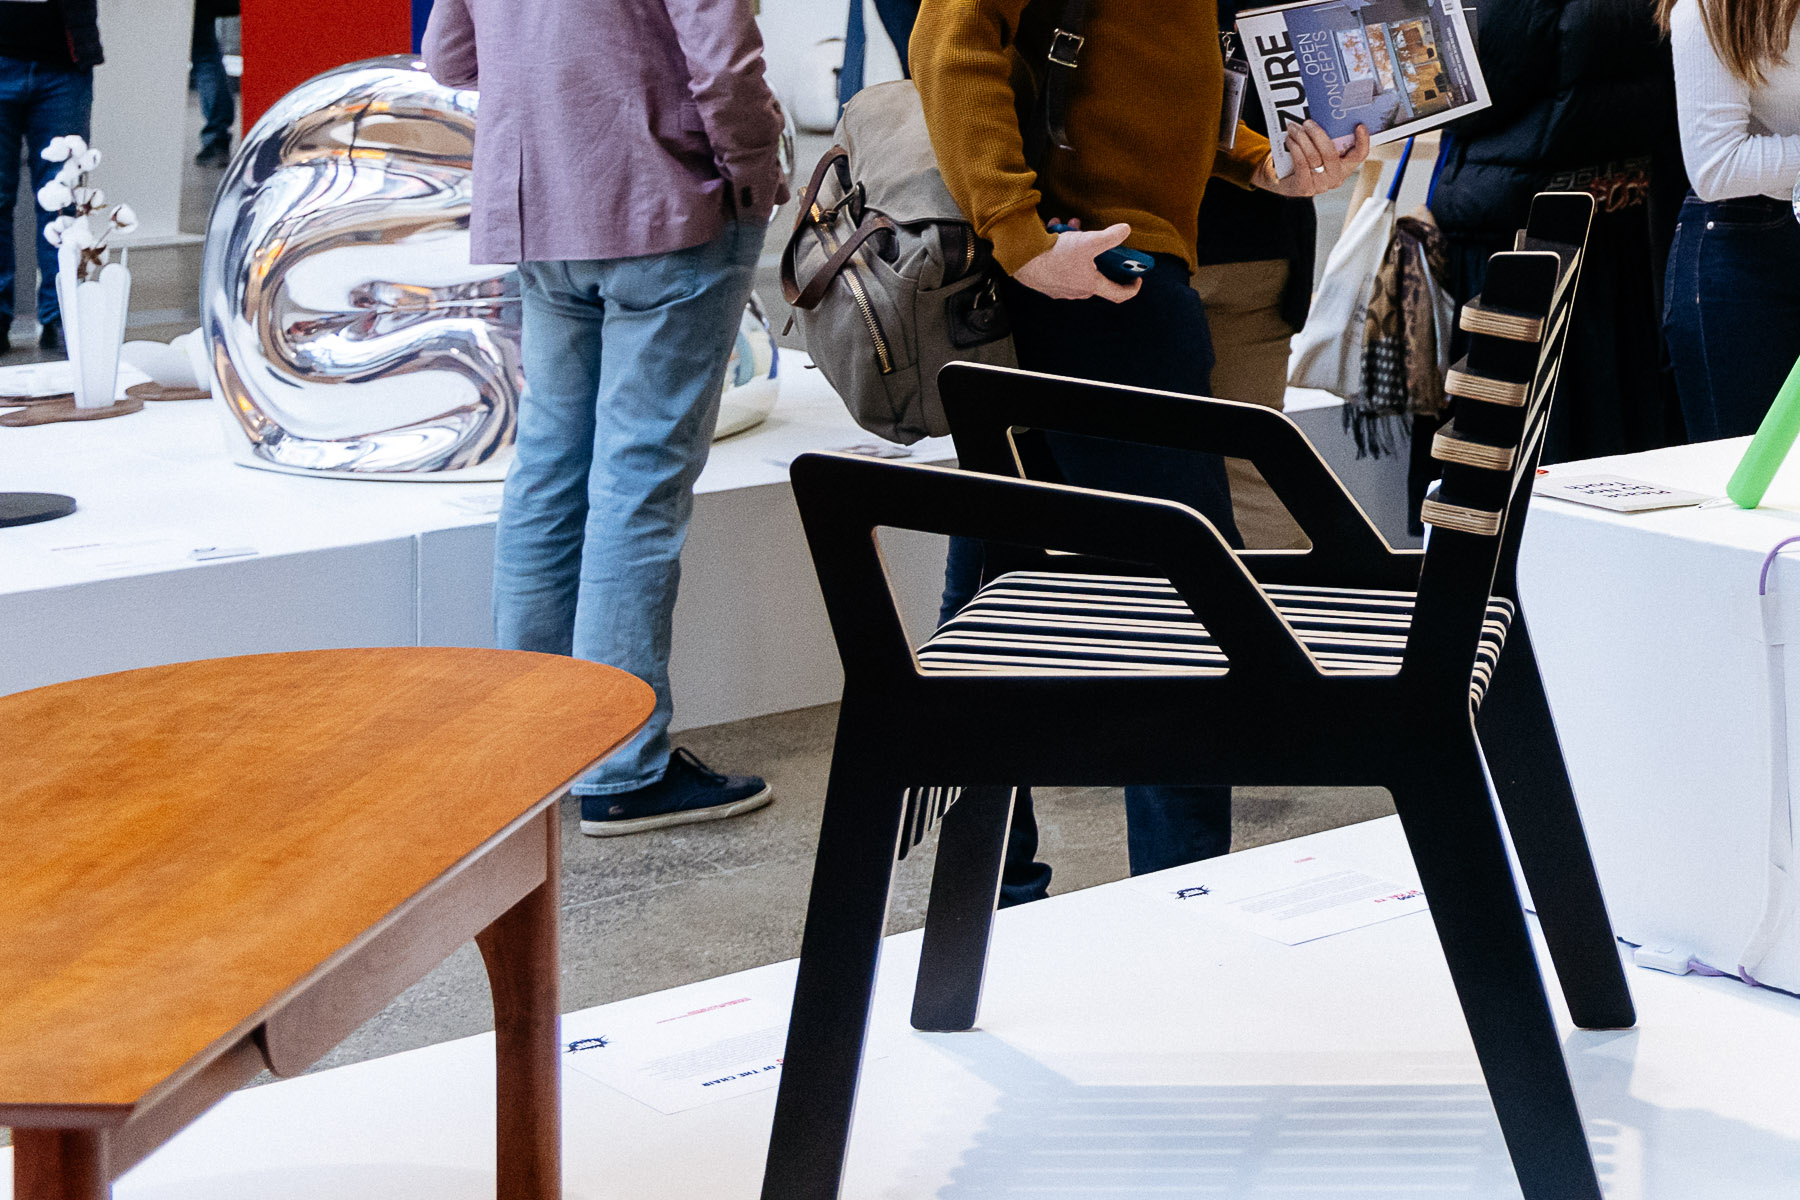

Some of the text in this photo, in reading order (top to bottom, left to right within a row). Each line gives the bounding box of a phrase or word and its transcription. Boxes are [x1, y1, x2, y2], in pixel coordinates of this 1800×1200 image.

[1296, 32, 1321, 76] OPEN
[1312, 30, 1345, 120] CONCEPTS
[1255, 27, 1311, 152] ZURE
[701, 1075, 736, 1087] CHAIR
[737, 1069, 758, 1078] THE
